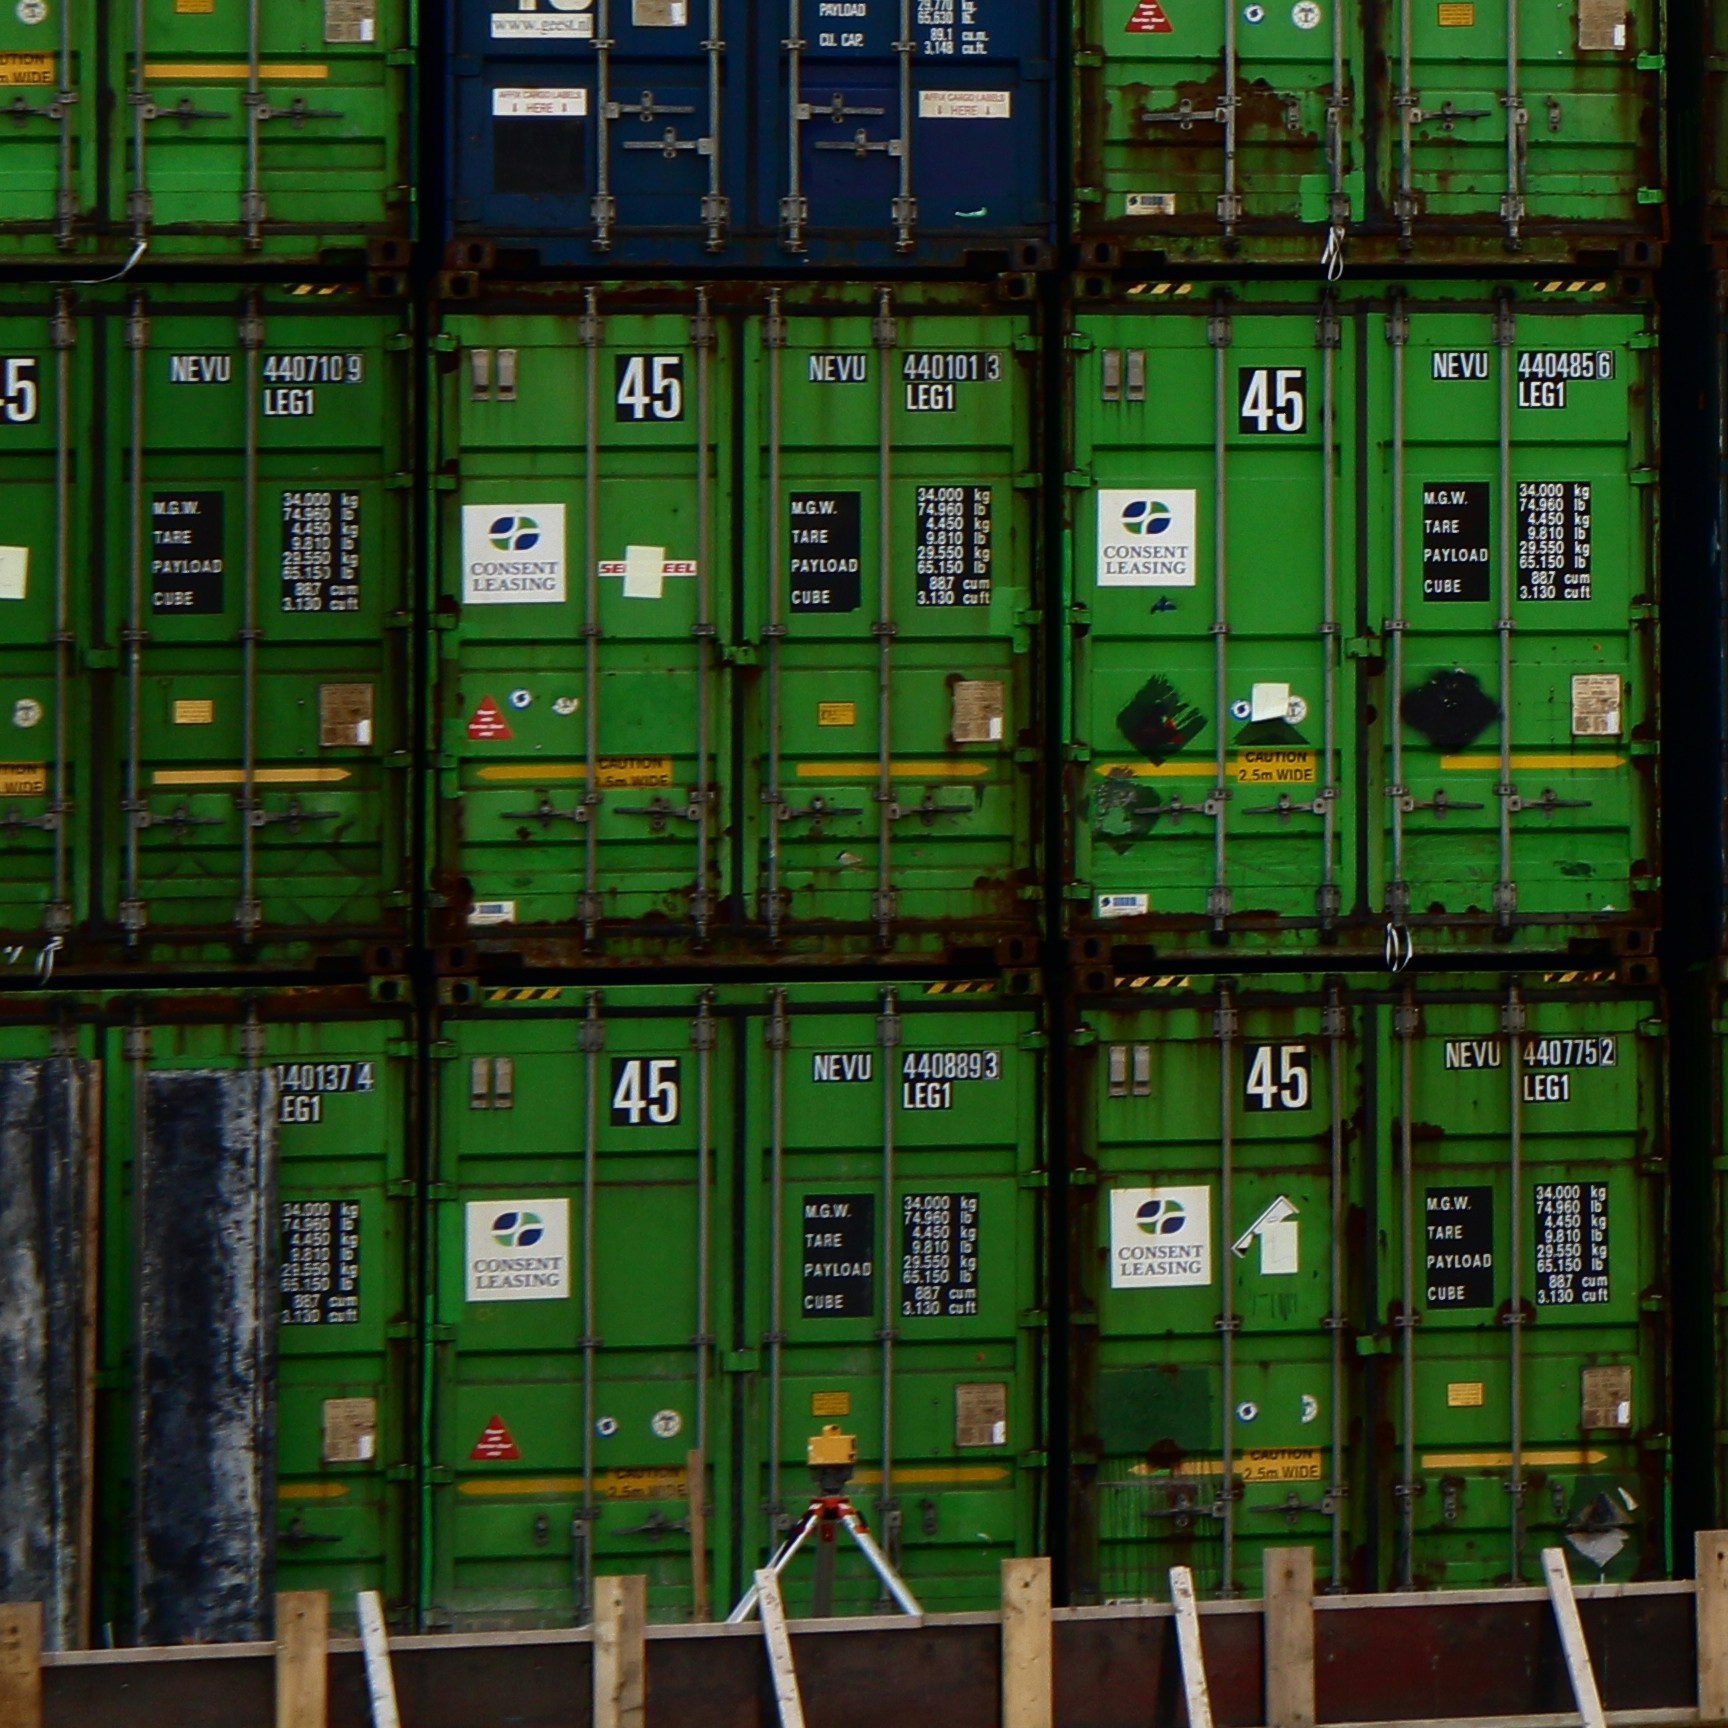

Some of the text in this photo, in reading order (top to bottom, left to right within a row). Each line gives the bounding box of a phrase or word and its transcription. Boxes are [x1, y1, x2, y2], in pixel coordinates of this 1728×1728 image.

[820, 2, 866, 18] PAYLOAD
[810, 356, 865, 380] NEVU
[904, 355, 976, 379] 440101
[619, 357, 679, 418] 45
[908, 385, 952, 409] LEG1
[1243, 370, 1302, 431] 45
[1244, 751, 1308, 764] CAUTION
[1276, 768, 1313, 783] WIDE
[815, 1055, 870, 1080] NEVU
[904, 1053, 980, 1078] 440889
[1248, 1046, 1306, 1108] 45
[615, 1061, 675, 1122] 45
[904, 1083, 949, 1108] LEG1
